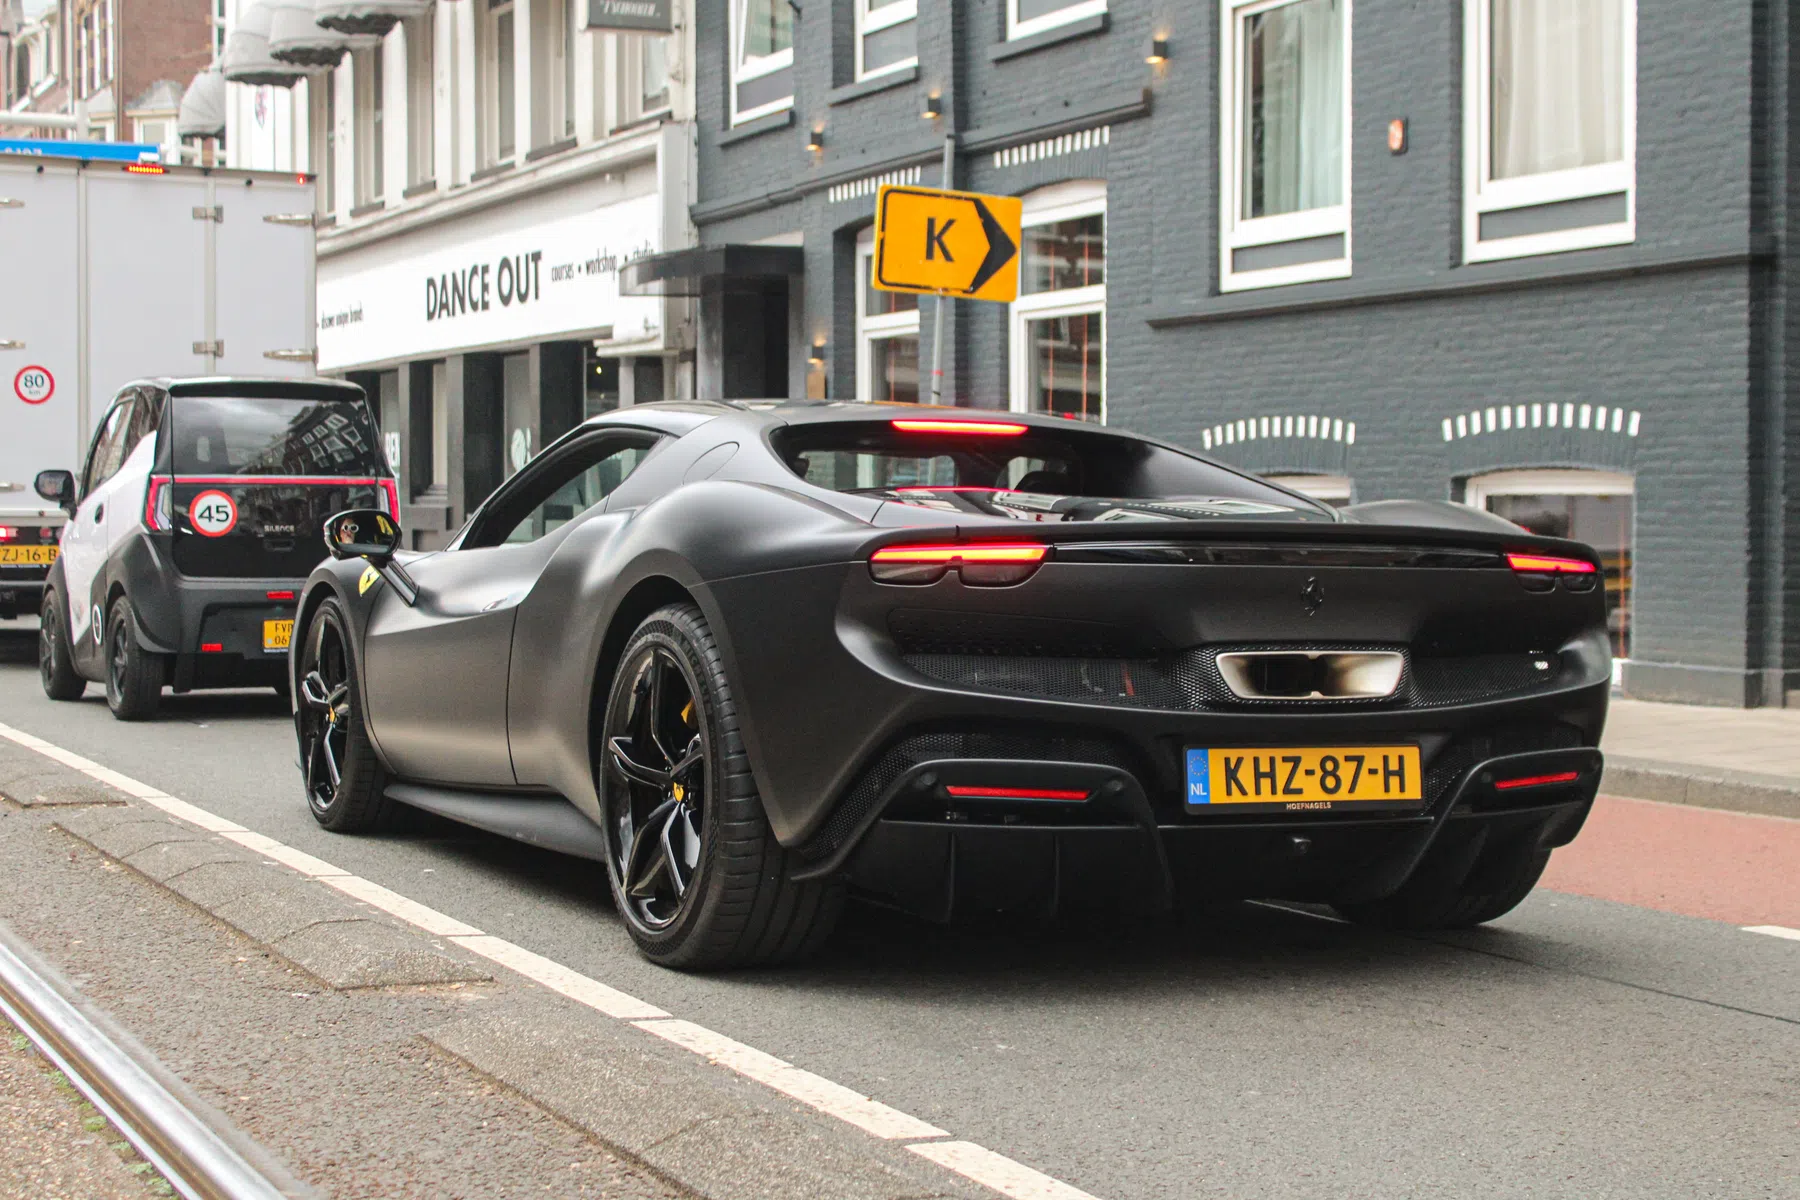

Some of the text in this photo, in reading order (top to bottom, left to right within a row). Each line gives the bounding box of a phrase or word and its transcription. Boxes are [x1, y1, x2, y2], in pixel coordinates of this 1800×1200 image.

[925, 217, 957, 262] K
[551, 262, 575, 282] courses
[426, 250, 542, 321] DANCE OUT
[24, 373, 44, 388] 80
[198, 504, 229, 522] 45
[0, 548, 57, 561] ZJ-16-B
[1224, 755, 1406, 796] KHZ-87-H
[1190, 783, 1207, 796] NL
[1286, 801, 1332, 810] HOEFNAGELS
